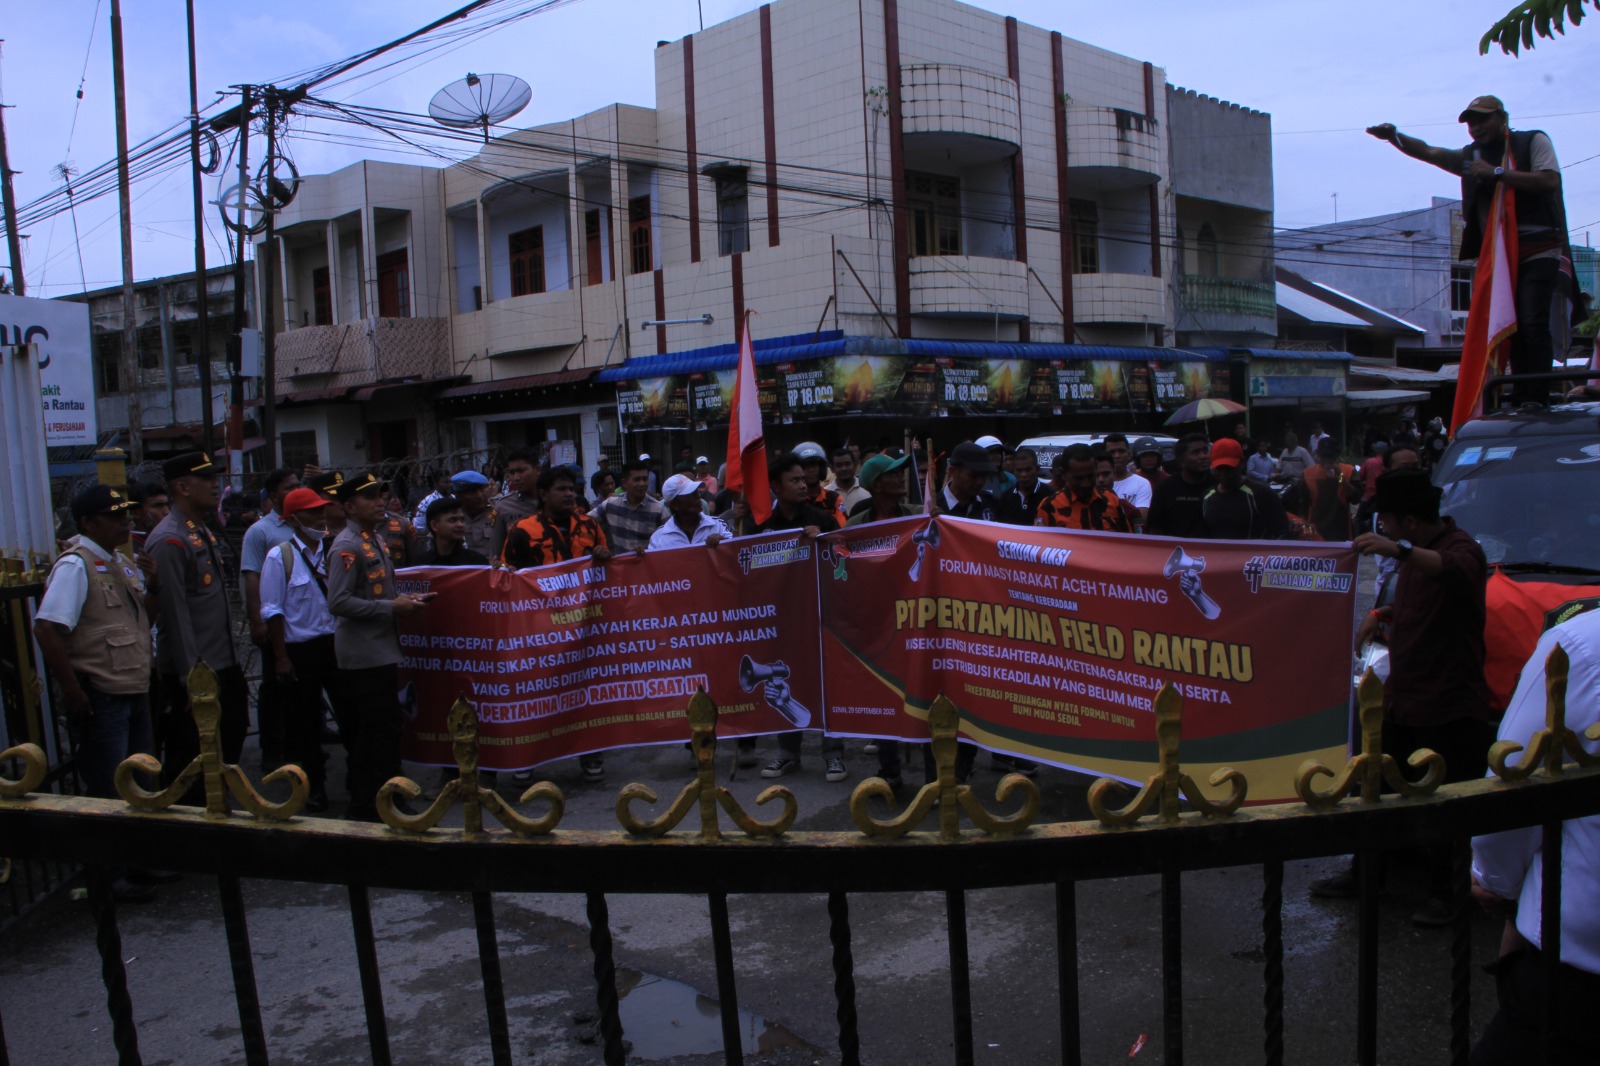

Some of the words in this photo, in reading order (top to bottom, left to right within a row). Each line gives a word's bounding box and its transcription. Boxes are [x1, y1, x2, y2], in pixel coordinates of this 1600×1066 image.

[41, 385, 61, 396] akit
[787, 389, 799, 407] RP
[801, 385, 834, 406] 18.000
[1059, 383, 1069, 400] RP
[52, 399, 85, 411] Rantau
[53, 422, 86, 432] PERUSAHAAN
[752, 539, 799, 556] KOLABORASI
[997, 540, 1041, 564] SERUAN
[1040, 547, 1072, 567] AKSI
[1264, 556, 1337, 573] KOLABORASI
[397, 580, 431, 594] RMAT
[536, 571, 580, 592] SERUAN
[939, 558, 982, 577] FORUM
[984, 563, 1058, 590] MASYARAKAT
[1062, 577, 1097, 596] ACEH
[1099, 582, 1169, 604] TAMIANG
[1266, 572, 1313, 588] TAMIANG
[1315, 574, 1349, 590] MAJU
[511, 591, 592, 613] MASYARAKAT
[592, 584, 628, 600] ACEH
[630, 579, 692, 597] TAMIANG
[1008, 588, 1035, 604] TENTANG
[1035, 595, 1079, 611] KEBERADAAN
[400, 634, 428, 648] GERA
[431, 636, 494, 652] PERCEPAT
[496, 637, 524, 651] ALIH
[526, 629, 575, 648] KELOLA
[632, 615, 678, 632] KERJA
[680, 611, 718, 626] ATAU
[722, 604, 777, 622] MUNDUR
[444, 658, 494, 674] ADALAH
[497, 659, 536, 674] SIKAP
[539, 648, 586, 668] KSATRIA
[586, 643, 616, 658] DAN
[619, 639, 656, 655] SATU
[670, 632, 734, 649] SATUNYA
[736, 626, 778, 642] JALAN
[895, 599, 916, 630] PT
[917, 597, 1057, 646] PERTAMINA
[1060, 615, 1125, 661] FIELD
[1132, 628, 1254, 683] RANTAU
[472, 682, 510, 697] YANG
[515, 675, 559, 695] HARUS
[561, 664, 619, 686] DITEMPUH
[622, 657, 692, 675] PIMPINAN
[932, 658, 991, 678] DISTRIBUSI
[993, 667, 1050, 689] KEADILAN
[1053, 677, 1086, 695] YANG
[1088, 684, 1125, 705] BELUM
[1066, 658, 1183, 696] KETENAGAKERJAN
[1185, 685, 1232, 704] SERTA
[481, 695, 560, 723] PERTAMINA
[560, 688, 588, 712] FIELD
[588, 680, 646, 705] RANTAU
[646, 675, 684, 699] SAAT
[1004, 691, 1051, 709] PERJUANGAN
[1053, 700, 1078, 715] NYATA
[1080, 705, 1110, 721] FORMAT
[1111, 713, 1135, 728] UNTUK
[855, 707, 882, 715] SEPTEMBER
[883, 708, 896, 716] 2025
[1012, 704, 1031, 716] BUMI
[1033, 708, 1056, 721] MUDA
[480, 736, 513, 746] BERHENTI
[588, 713, 634, 728] KEBERANIAN
[636, 711, 664, 722] ADALAH
[718, 703, 755, 714] EGALANYA
